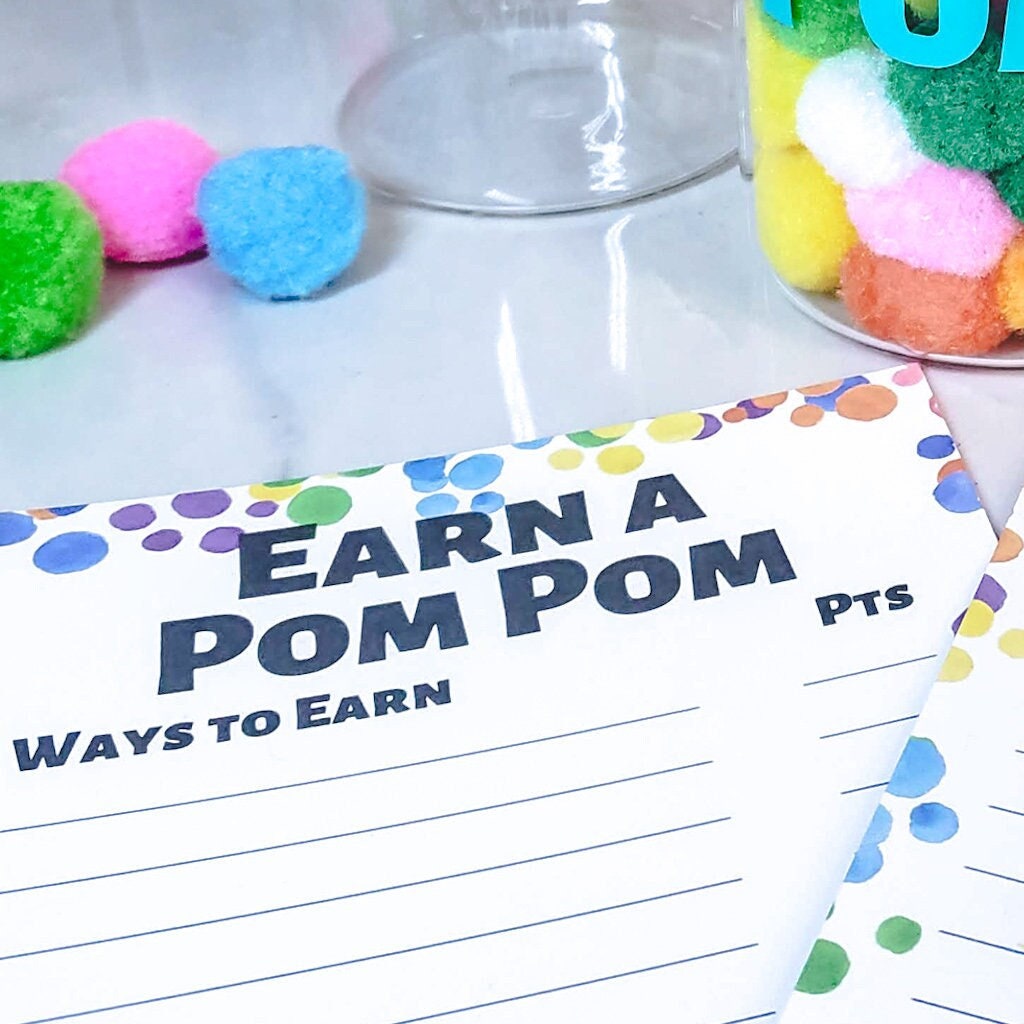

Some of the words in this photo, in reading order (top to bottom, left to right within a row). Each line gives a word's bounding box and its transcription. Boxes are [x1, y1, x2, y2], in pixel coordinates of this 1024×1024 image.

[237, 490, 593, 601] EARN
[625, 473, 707, 532] A
[157, 591, 469, 697] POM
[498, 527, 798, 639] POM
[815, 583, 914, 627] PTS
[13, 720, 196, 772] WAYS
[207, 709, 283, 743] TO
[295, 679, 453, 731] EARN
